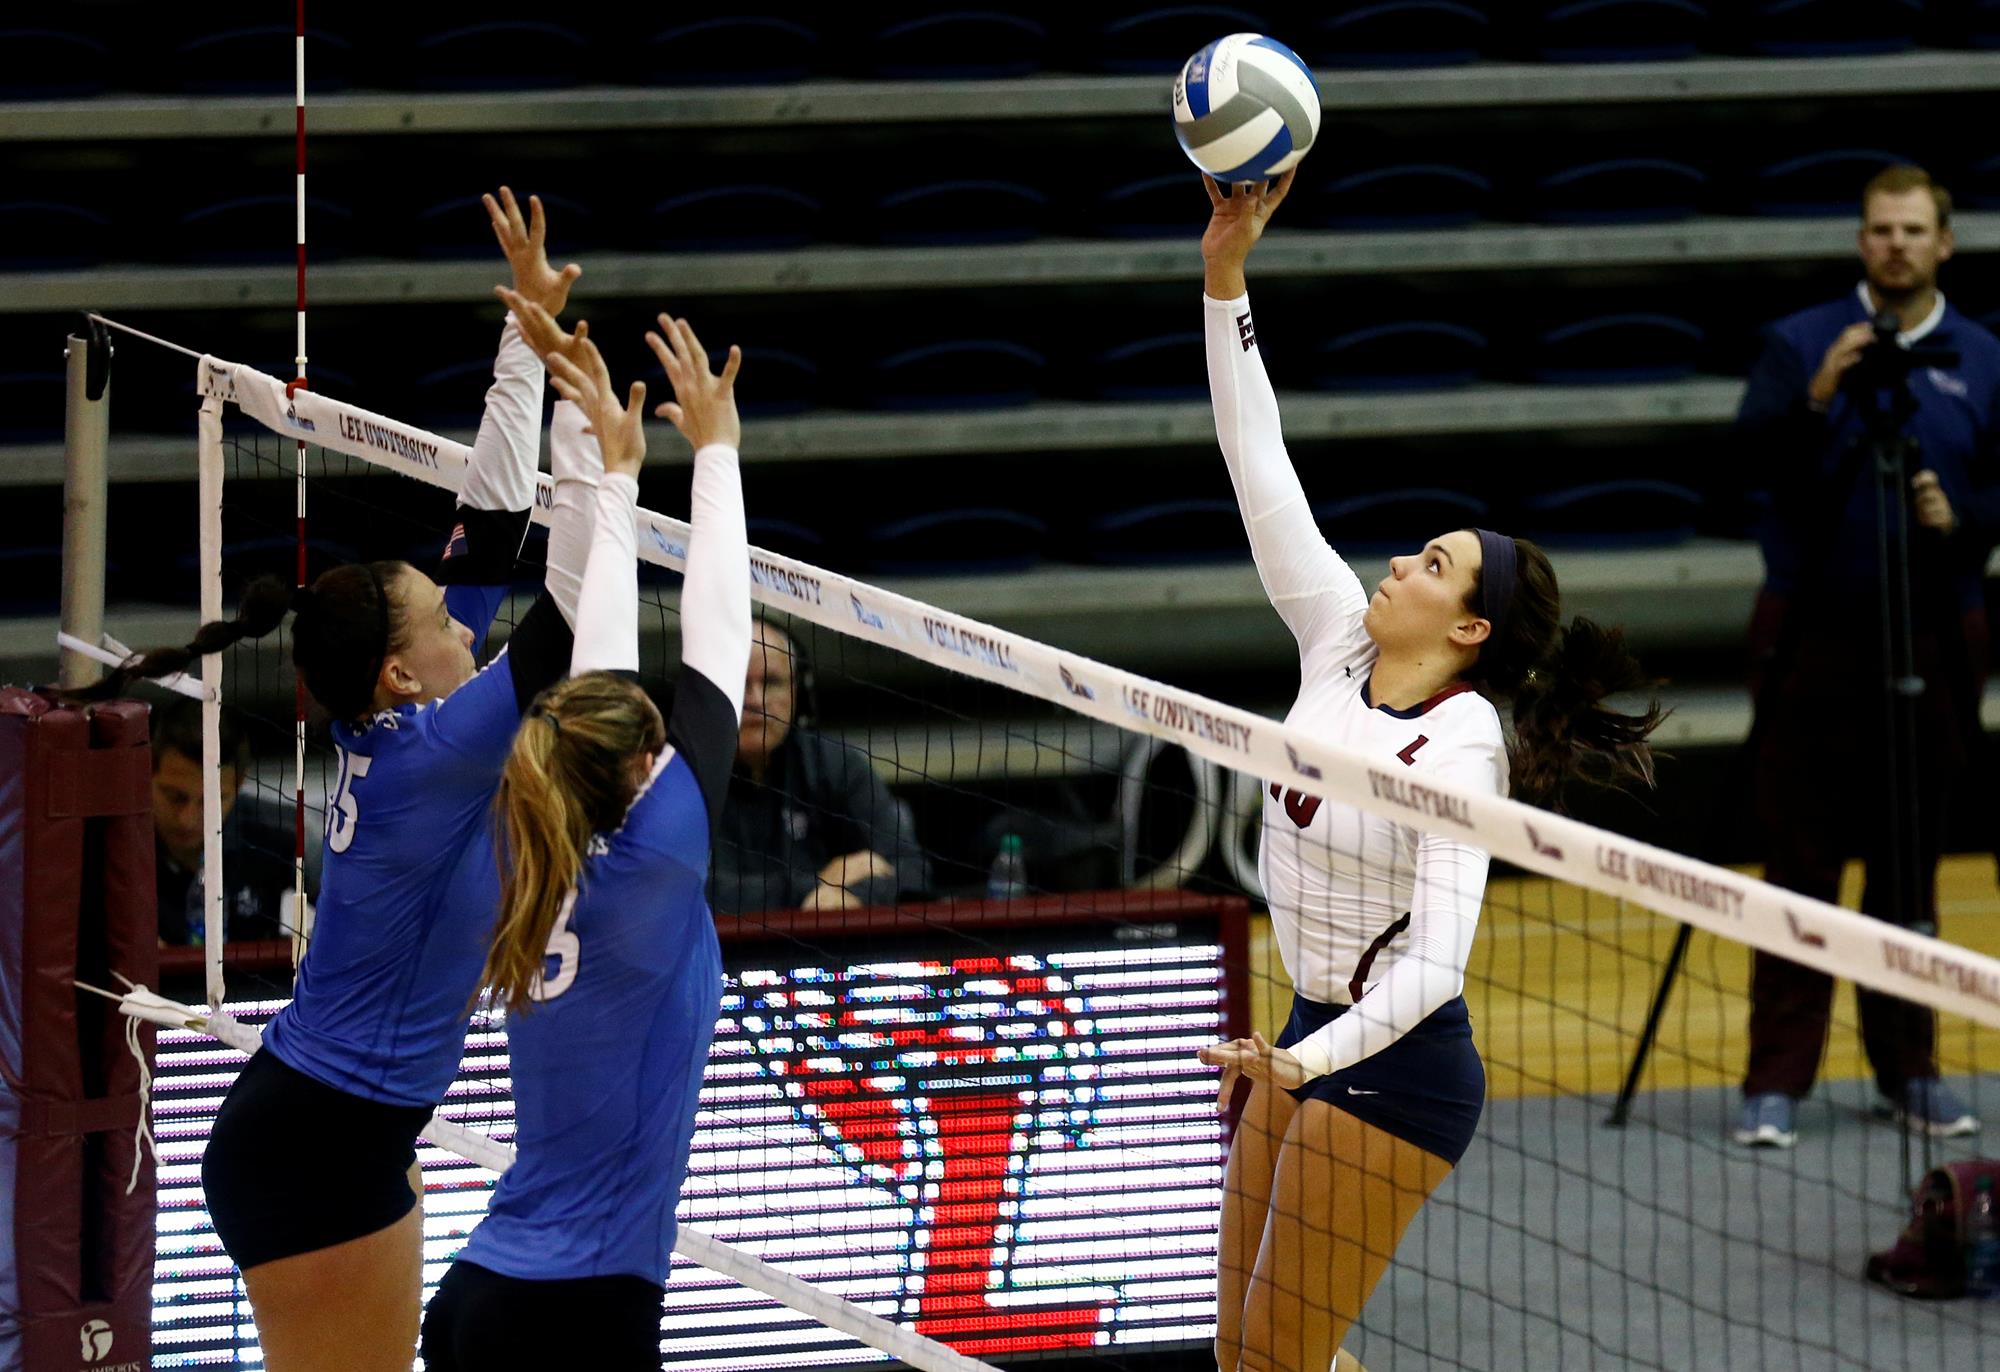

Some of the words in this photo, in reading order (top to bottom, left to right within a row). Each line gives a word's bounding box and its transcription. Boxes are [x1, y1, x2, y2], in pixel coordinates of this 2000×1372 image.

[339, 413, 364, 443] LEE
[364, 421, 438, 469] UNIVERSITY
[1123, 685, 1149, 718] LEE
[1153, 696, 1251, 754] UNIVERSITY
[1596, 845, 1629, 881] LEE
